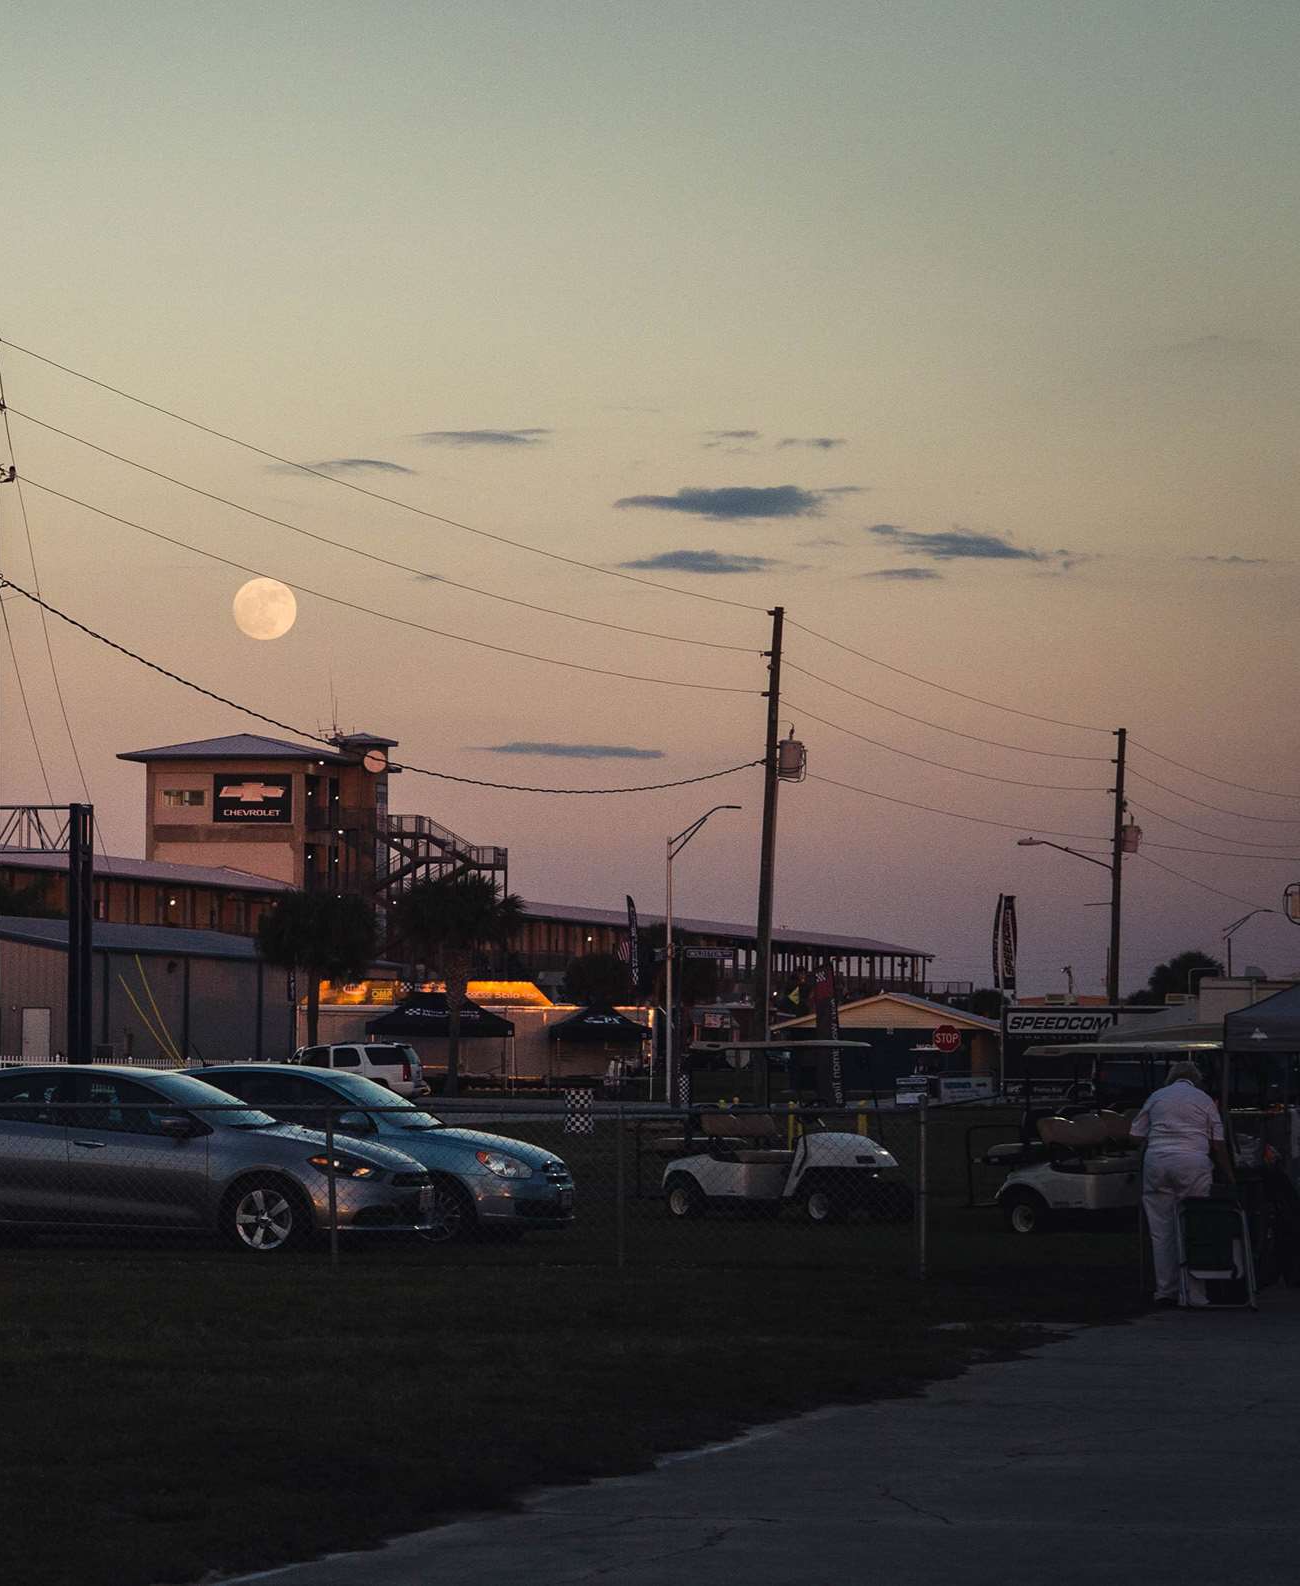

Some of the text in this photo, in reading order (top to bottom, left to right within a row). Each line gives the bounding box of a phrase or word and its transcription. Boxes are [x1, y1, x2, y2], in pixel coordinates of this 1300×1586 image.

[223, 808, 281, 817] CHEVROLET
[1009, 1016, 1111, 1030] SPEEDCOM
[935, 1032, 960, 1045] STOP
